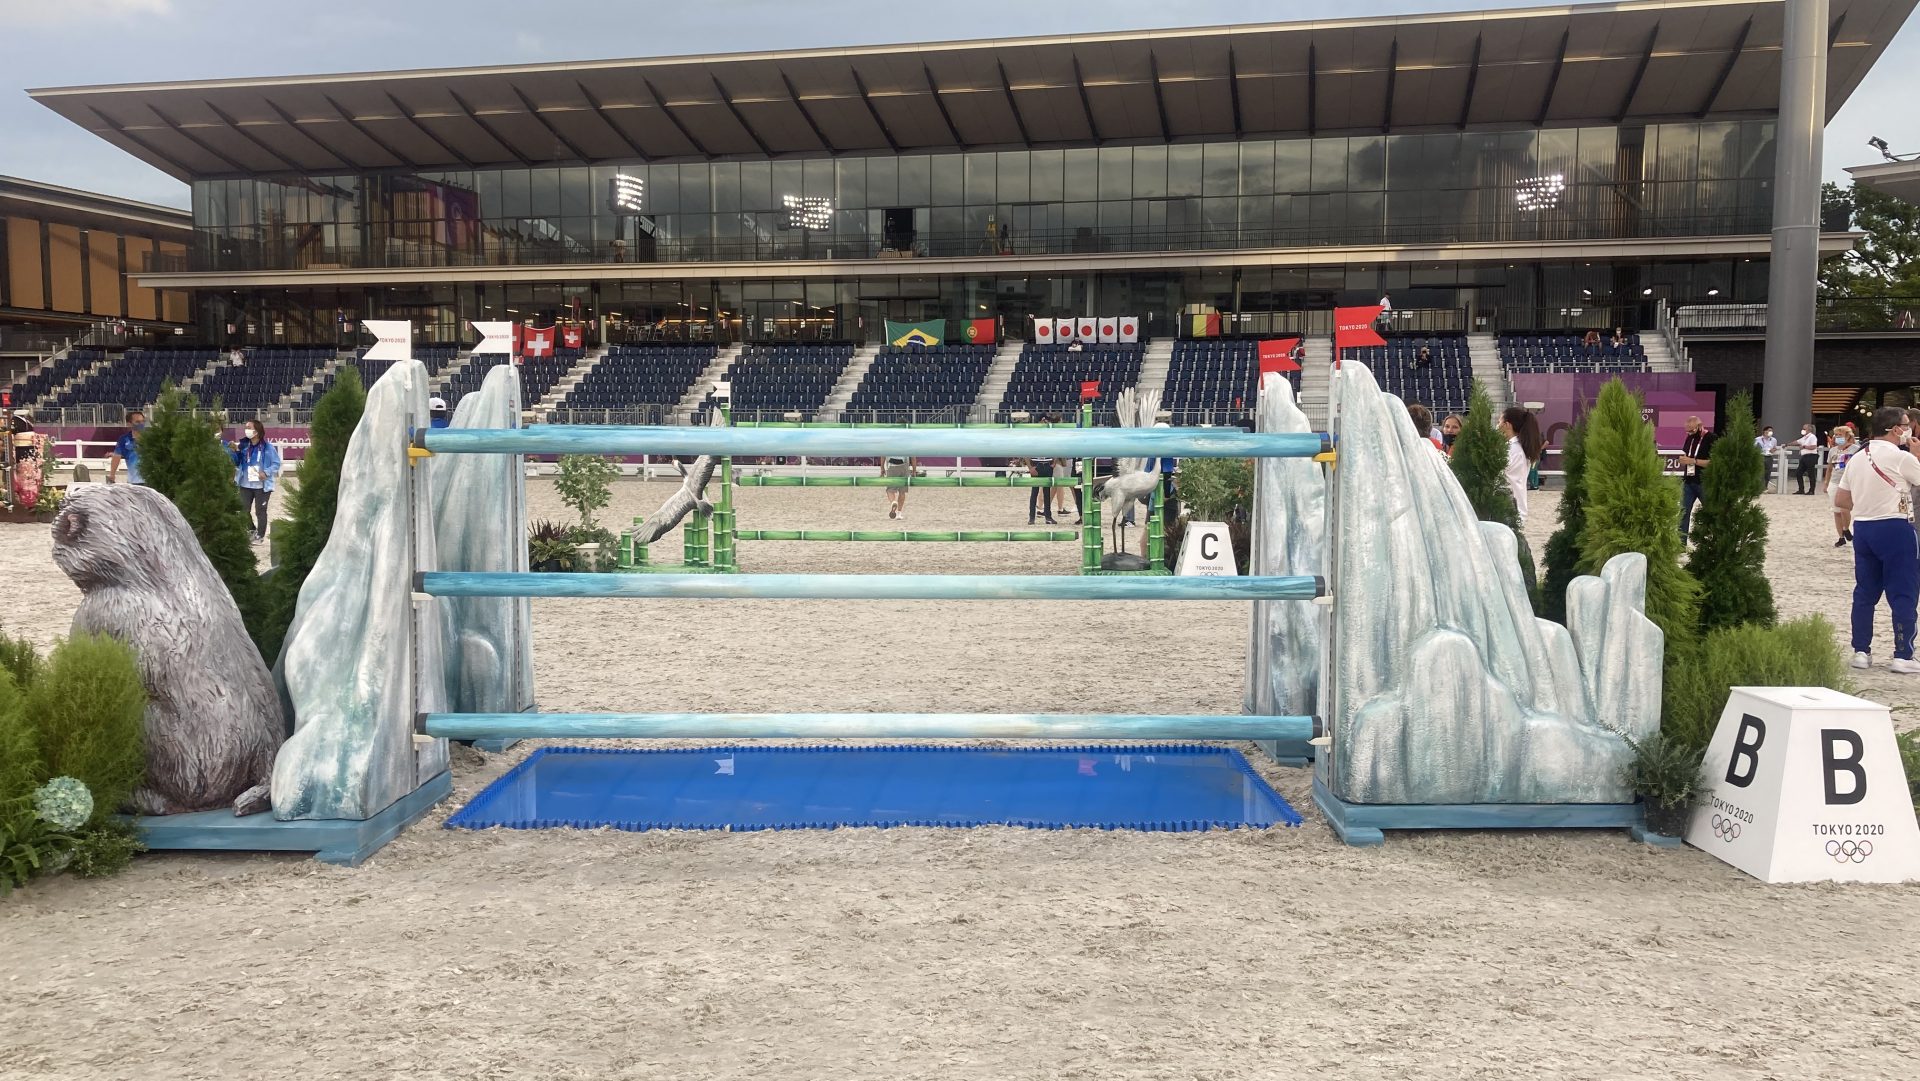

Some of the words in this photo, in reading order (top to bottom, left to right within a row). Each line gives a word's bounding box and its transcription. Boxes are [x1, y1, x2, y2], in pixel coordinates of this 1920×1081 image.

[291, 438, 311, 448] 202
[1200, 532, 1218, 560] C
[1725, 712, 1766, 788] B
[1821, 728, 1868, 805] B
[1710, 796, 1734, 816] TOKYO
[1734, 808, 1754, 824] 2020
[1812, 824, 1852, 836] TOKYO
[1855, 824, 1884, 836] 2020
